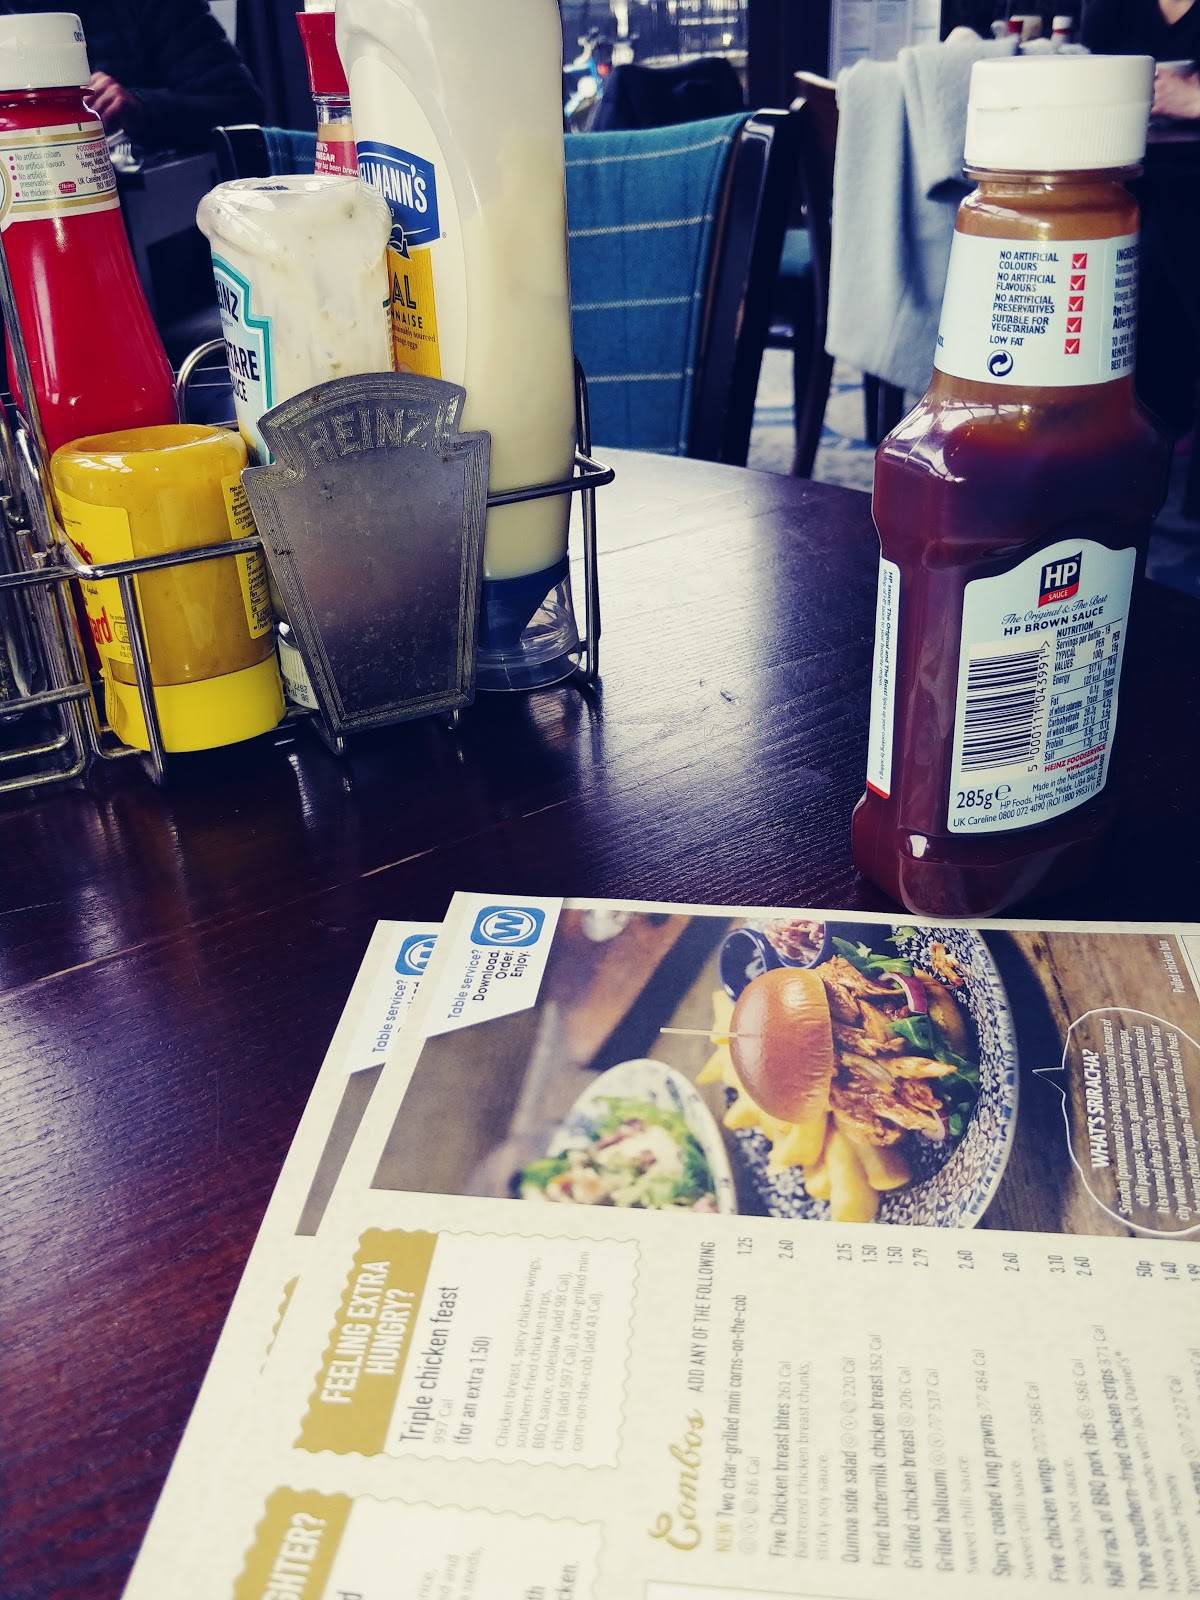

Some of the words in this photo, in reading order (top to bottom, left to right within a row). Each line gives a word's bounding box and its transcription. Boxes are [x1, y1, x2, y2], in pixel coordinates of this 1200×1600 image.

[360, 162, 428, 213] ELLMANN'S
[999, 261, 1037, 271] COLOURS
[1000, 251, 1011, 260] NO
[1013, 252, 1059, 262] ARTIFICIAL
[392, 271, 417, 310] AL
[996, 282, 1036, 292] FLAVOURS
[997, 272, 1009, 281] NO
[1011, 274, 1056, 284] ARTIFICIAL
[993, 303, 1055, 314] PRESERVATIVES
[994, 294, 1006, 303] NO
[1008, 295, 1053, 305] ARTIFICIAL
[991, 323, 1046, 334] VEGETARIANS
[992, 314, 1029, 325] SUITABLE
[1032, 316, 1049, 326] FOR
[989, 335, 1008, 345] LOW
[1010, 337, 1024, 346] FAT
[298, 406, 432, 469] HEINZ
[1044, 562, 1078, 589] HP
[1001, 614, 1022, 625] The
[1023, 606, 1061, 623] Original
[1069, 599, 1088, 611] The
[1089, 593, 1108, 607] Best
[1048, 589, 1069, 601] SAUCE
[1003, 626, 1021, 636] HP
[1025, 617, 1069, 633] BROWN
[1072, 605, 1104, 622] SAUCE
[1056, 620, 1094, 638] NUTRITION
[1055, 647, 1076, 661] TYPICAL
[1056, 637, 1078, 650] Servings
[1054, 658, 1073, 672] VALUES
[1053, 674, 1071, 685] Energy
[1044, 760, 1066, 772] HEINZ
[1067, 743, 1107, 765] FOODSERVICE
[1045, 737, 1063, 750] Protein
[1032, 782, 1049, 792] Made
[1057, 776, 1066, 784] the
[1068, 764, 1098, 780] Netherlands
[956, 789, 993, 810] 285g
[1000, 800, 1011, 810] HP
[953, 817, 966, 827] UK
[967, 814, 997, 825] Careline
[998, 810, 1015, 820] 0800
[1016, 806, 1029, 817] 072
[472, 950, 500, 1001] Download.
[495, 950, 515, 980] Order.
[510, 950, 530, 978] Enjoy.
[448, 990, 468, 1019] Table
[463, 949, 483, 989] service?
[372, 1023, 393, 1053] Table
[386, 979, 409, 1021] service?
[1105, 1056, 1118, 1083] delicious
[1135, 1049, 1150, 1077] Thailand
[1082, 1048, 1105, 1115] SRIRACHA?
[1087, 1116, 1110, 1169] WHAT'S
[1135, 1186, 1150, 1207] chilli
[1151, 1168, 1168, 1197] named
[1117, 1180, 1133, 1214] Sriracha
[737, 1236, 753, 1255] 1.25
[778, 1239, 794, 1259] 2.60
[837, 1242, 853, 1262] 2.15
[862, 1244, 878, 1263] 1.50
[887, 1246, 903, 1265] 1.50
[912, 1247, 929, 1267] 2.79
[957, 1249, 974, 1270] 2.60
[695, 1240, 716, 1301] FOLLOWING
[1002, 1252, 1020, 1272] 2.60
[1047, 1255, 1065, 1273] 3.10
[1073, 1256, 1093, 1277] 2.60
[1136, 1260, 1155, 1278] 50p
[1160, 1261, 1181, 1281] 1.40
[430, 1287, 460, 1323] feast
[693, 1303, 712, 1322] THE
[320, 1323, 371, 1404] FEELING
[346, 1261, 391, 1318] EXTRA
[364, 1289, 416, 1375] HUNGRY?
[692, 1325, 709, 1340] OF
[729, 1294, 748, 1388] corns-on-the-cob
[415, 1329, 449, 1389] chicken
[469, 1336, 492, 1363] 1.50)
[690, 1342, 708, 1366] ANY
[466, 1368, 485, 1399] extra
[687, 1369, 706, 1392] ADD
[869, 1375, 886, 1409] breast
[1100, 1368, 1120, 1400] strips
[438, 1399, 453, 1419] Cal
[463, 1403, 478, 1418] an
[723, 1390, 742, 1414] mini
[774, 1402, 791, 1430] bites
[399, 1396, 435, 1441] Triple
[1107, 1402, 1130, 1449] chicken
[433, 1421, 448, 1445] 997
[454, 1422, 473, 1445] (for
[869, 1411, 888, 1458] chicken
[980, 1413, 1003, 1458] prawns
[720, 1417, 743, 1489] char-grilled
[772, 1433, 790, 1472] breast
[899, 1430, 917, 1467] breast
[648, 1408, 705, 1551] Combos
[840, 1450, 858, 1484] salad
[984, 1461, 1004, 1490] king
[1036, 1458, 1056, 1494] wings
[715, 1492, 735, 1518] Two
[770, 1474, 789, 1526] Chicken
[841, 1487, 859, 1513] side
[870, 1464, 890, 1529] buttermilk
[902, 1471, 920, 1521] chicken
[931, 1469, 952, 1523] halloumi
[987, 1491, 1008, 1536] coated
[1041, 1498, 1064, 1550] chicken
[712, 1521, 733, 1553] NEW
[768, 1529, 787, 1557] Five
[841, 1517, 860, 1564] Quinoa
[872, 1531, 891, 1566] Fried
[904, 1524, 923, 1569] Grilled
[935, 1527, 955, 1572] Grilled
[262, 1511, 328, 1600] HTER?
